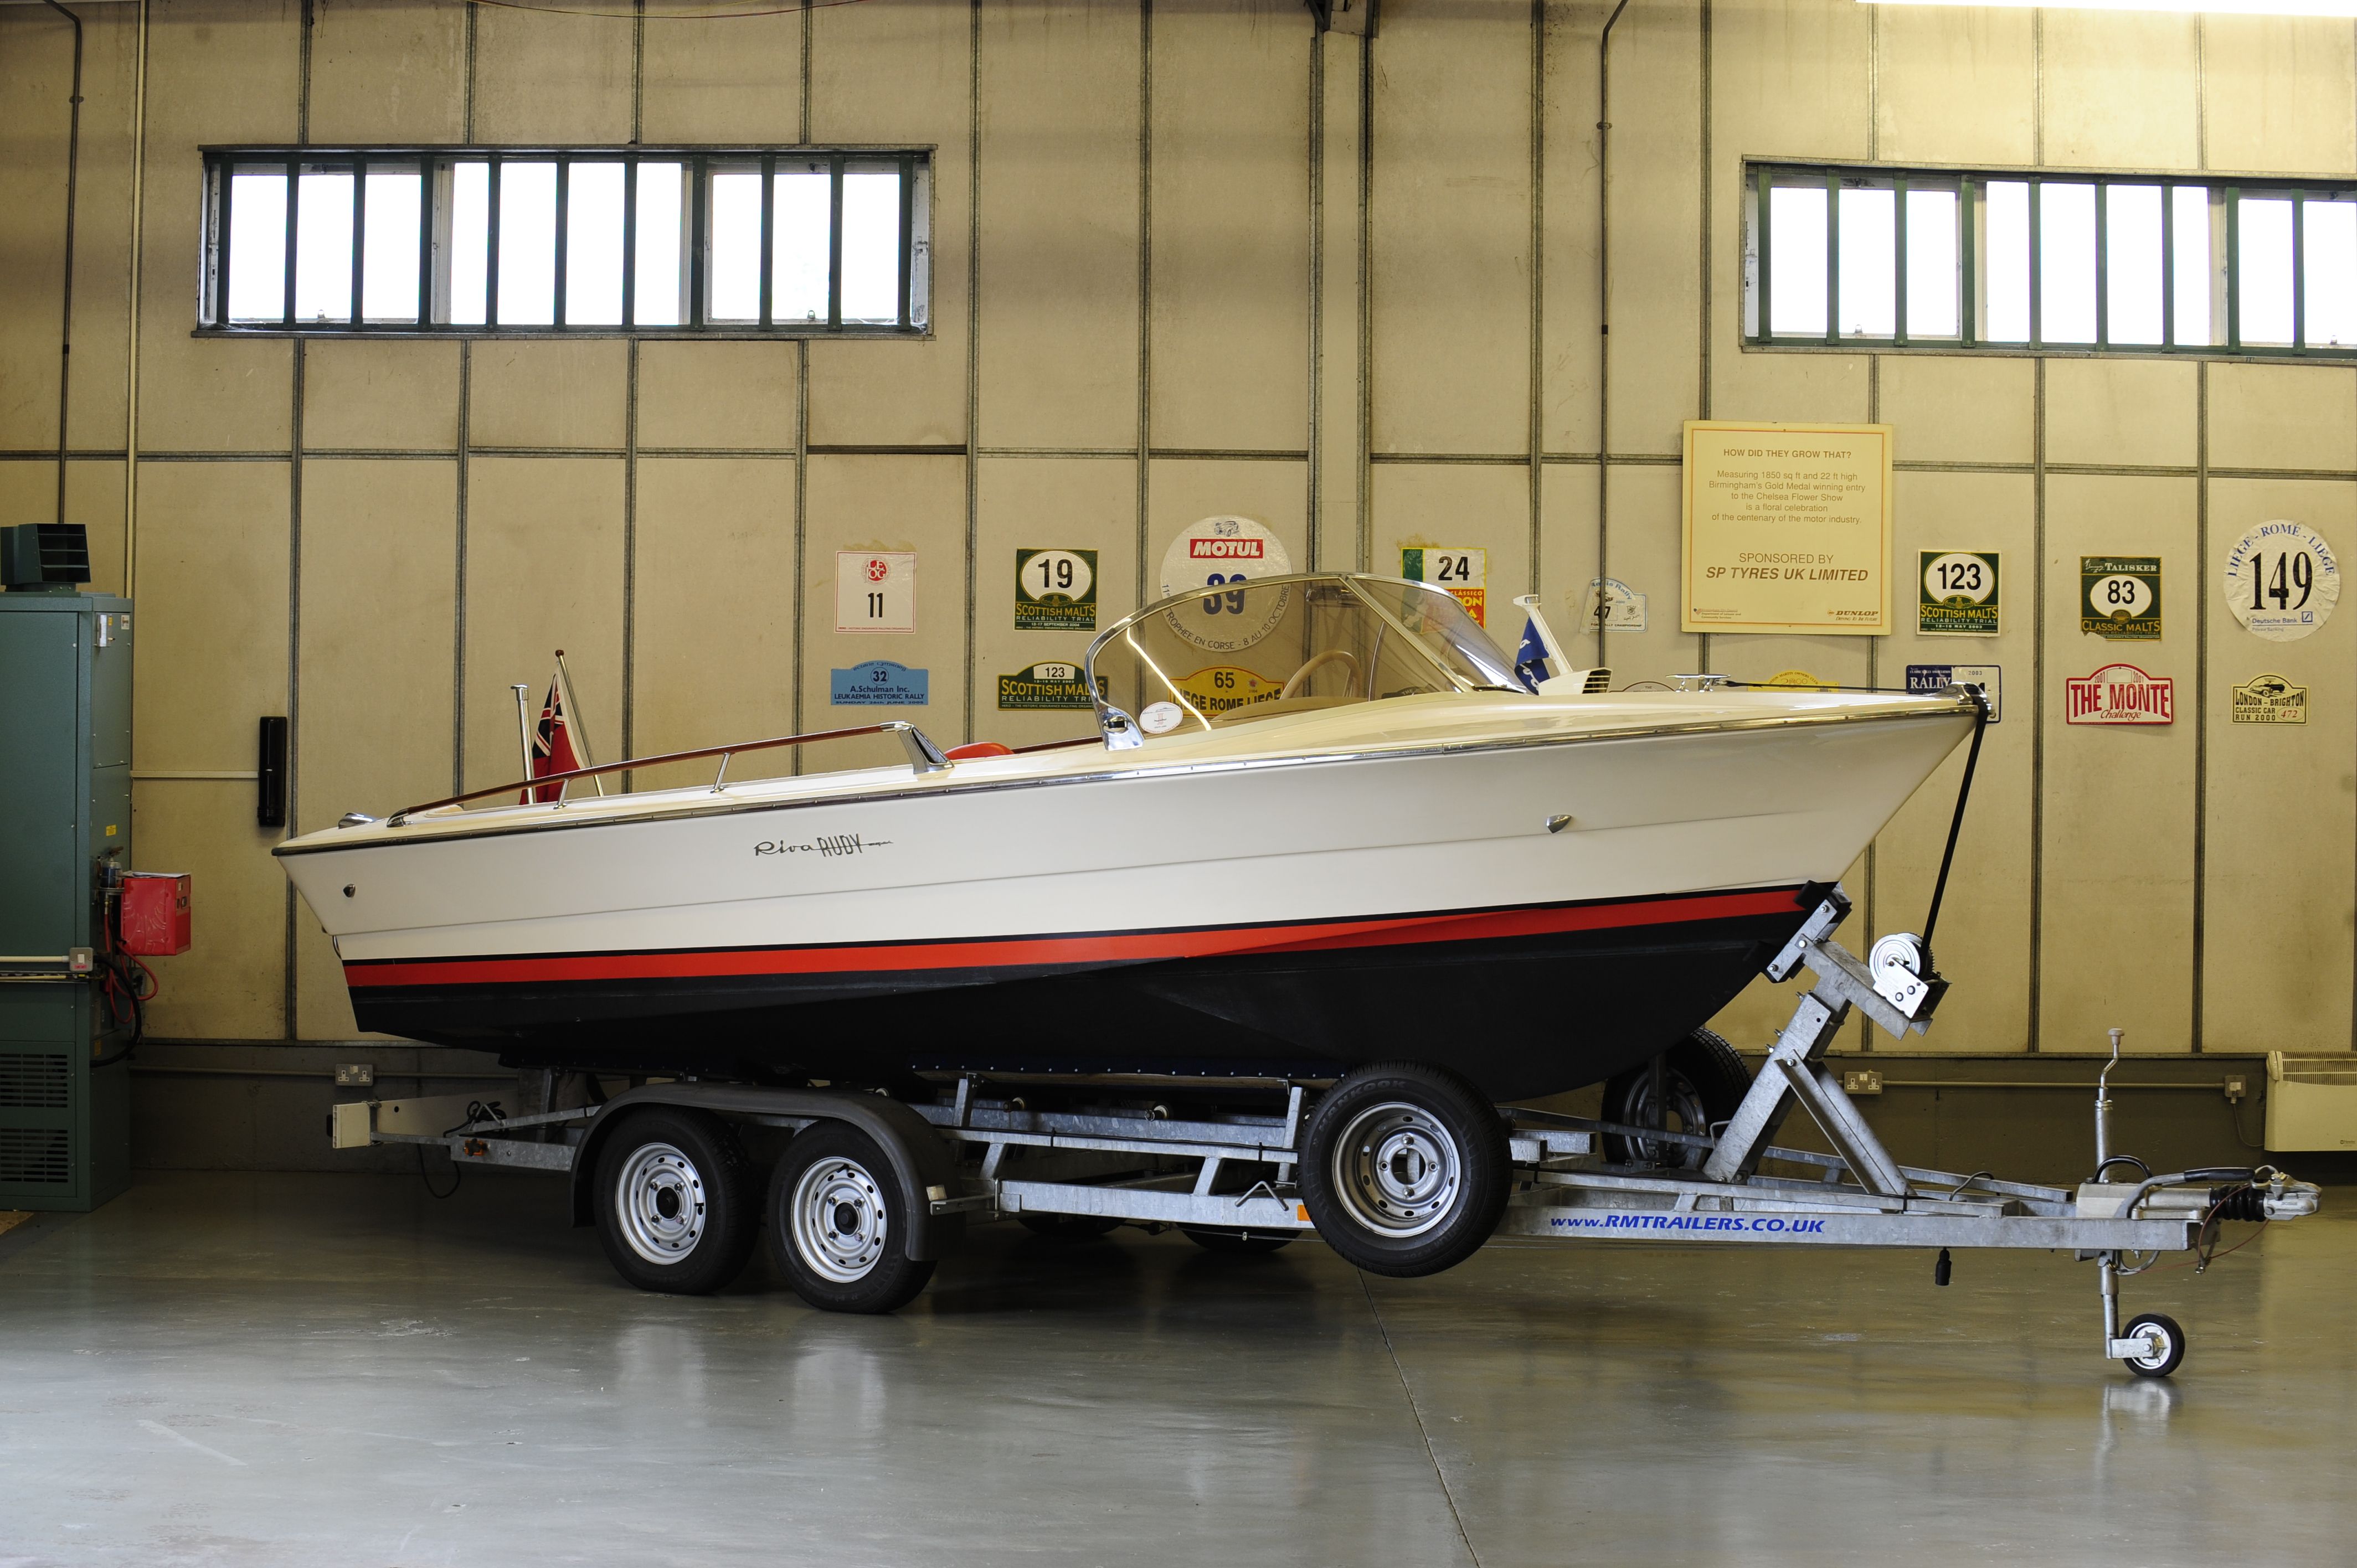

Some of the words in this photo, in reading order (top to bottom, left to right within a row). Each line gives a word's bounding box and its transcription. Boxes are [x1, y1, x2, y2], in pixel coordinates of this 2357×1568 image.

[1717, 471, 1758, 479] Measuring
[1841, 473, 1857, 482] high
[1709, 481, 1762, 490] Birmingham's
[1813, 483, 1843, 492] winning
[1737, 515, 1776, 523] centenary
[1829, 516, 1861, 524] industry.
[1193, 541, 1260, 556] MOTUL
[2227, 537, 2253, 576] LIEGE
[2261, 524, 2301, 537] ROME
[2308, 537, 2335, 576] LIEGE
[1739, 553, 1814, 564] SPONSORED
[1819, 555, 1834, 564] BY
[1038, 559, 1073, 588] 19
[1438, 556, 1469, 580] 24
[1706, 567, 1726, 578] SP
[1731, 568, 1779, 579] TYRES
[1784, 569, 1805, 580] UK
[1809, 569, 1868, 580] LIMITED
[2105, 563, 2157, 571] TALISKER
[1938, 563, 1981, 590] 123
[2250, 551, 2313, 610] 149
[1615, 584, 1632, 599] Rally
[2108, 580, 2135, 604] 83
[868, 593, 883, 617] 11
[1016, 604, 1062, 615] SCOTTISH
[1065, 605, 1095, 617] MALTS
[1921, 606, 1965, 617] SCOTTISH
[1968, 607, 1997, 618] MALTS
[1195, 636, 1205, 646] EN
[1208, 641, 1235, 649] CORSE
[1251, 631, 1262, 642] AU
[1262, 623, 1270, 632] 10
[1269, 585, 1289, 623] OCTOBRE
[2082, 621, 2122, 631] CLASSIC
[2127, 621, 2160, 631] MALTS
[873, 670, 887, 682] 32
[1046, 667, 1065, 677] 123
[2094, 672, 2106, 683] 2001
[2133, 671, 2144, 683] 2001
[1002, 679, 1062, 695] SCOTTISH
[1066, 680, 1105, 695] MALS
[1214, 672, 1235, 688] 65
[1910, 677, 1951, 689] RALLY
[1210, 698, 1244, 711] ROME
[2071, 684, 2102, 718] THE
[2109, 684, 2169, 719] MONTE
[2236, 689, 2262, 705] LONDON
[2270, 690, 2304, 706] BRIGHTON
[2101, 709, 2141, 721] Challenge
[754, 840, 813, 856] Riva
[1318, 1080, 1406, 1132] HANKOOK
[1551, 1215, 1825, 1232] www.RMTRAILERS.CO.UK
